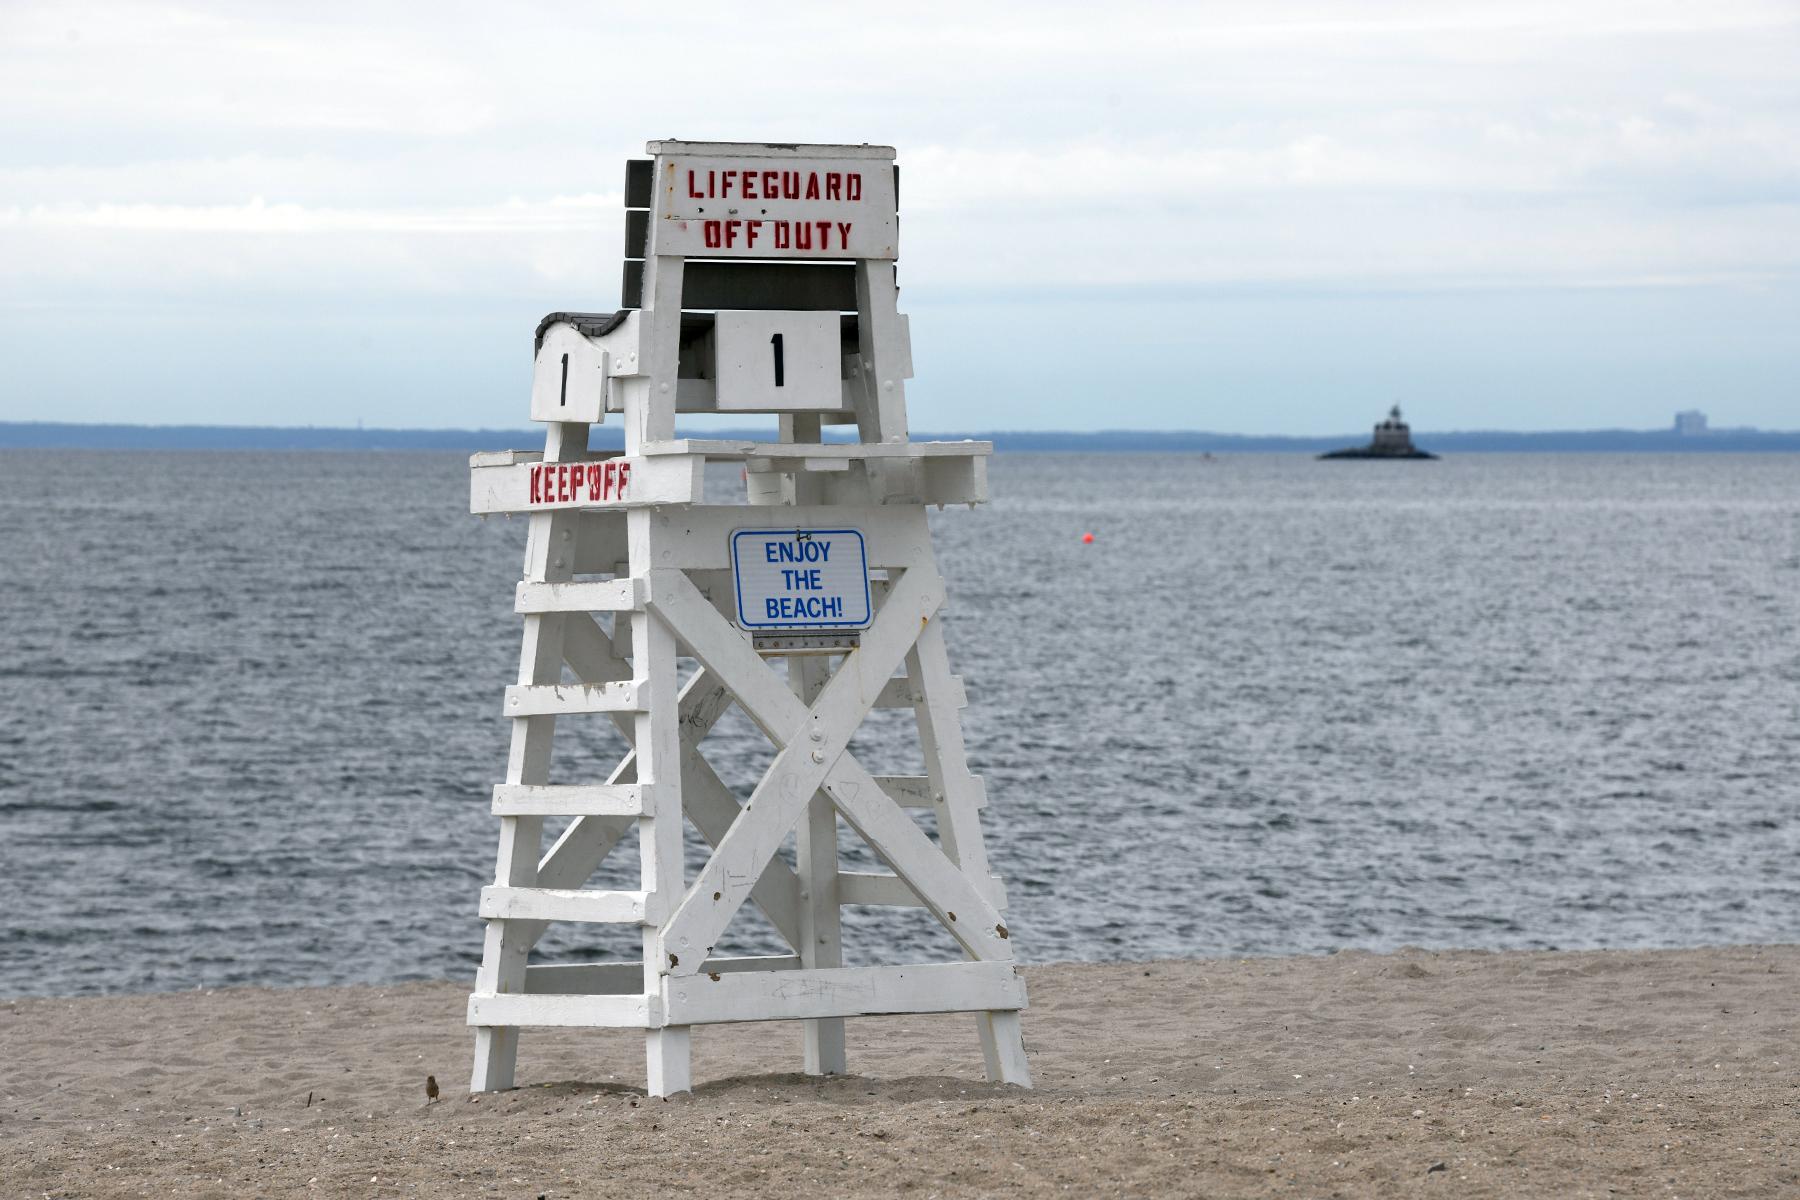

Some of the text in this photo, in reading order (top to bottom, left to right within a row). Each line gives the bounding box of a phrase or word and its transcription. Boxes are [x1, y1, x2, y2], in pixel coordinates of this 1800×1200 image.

[688, 170, 862, 201] LIFEGUARD
[704, 220, 853, 250] OFF DUTY
[770, 333, 784, 387] 1
[560, 353, 569, 407] 1
[530, 463, 631, 504] KEEP OFF
[765, 541, 831, 563] ENJOY
[781, 569, 823, 590] THE
[765, 597, 843, 619] BEACH!
